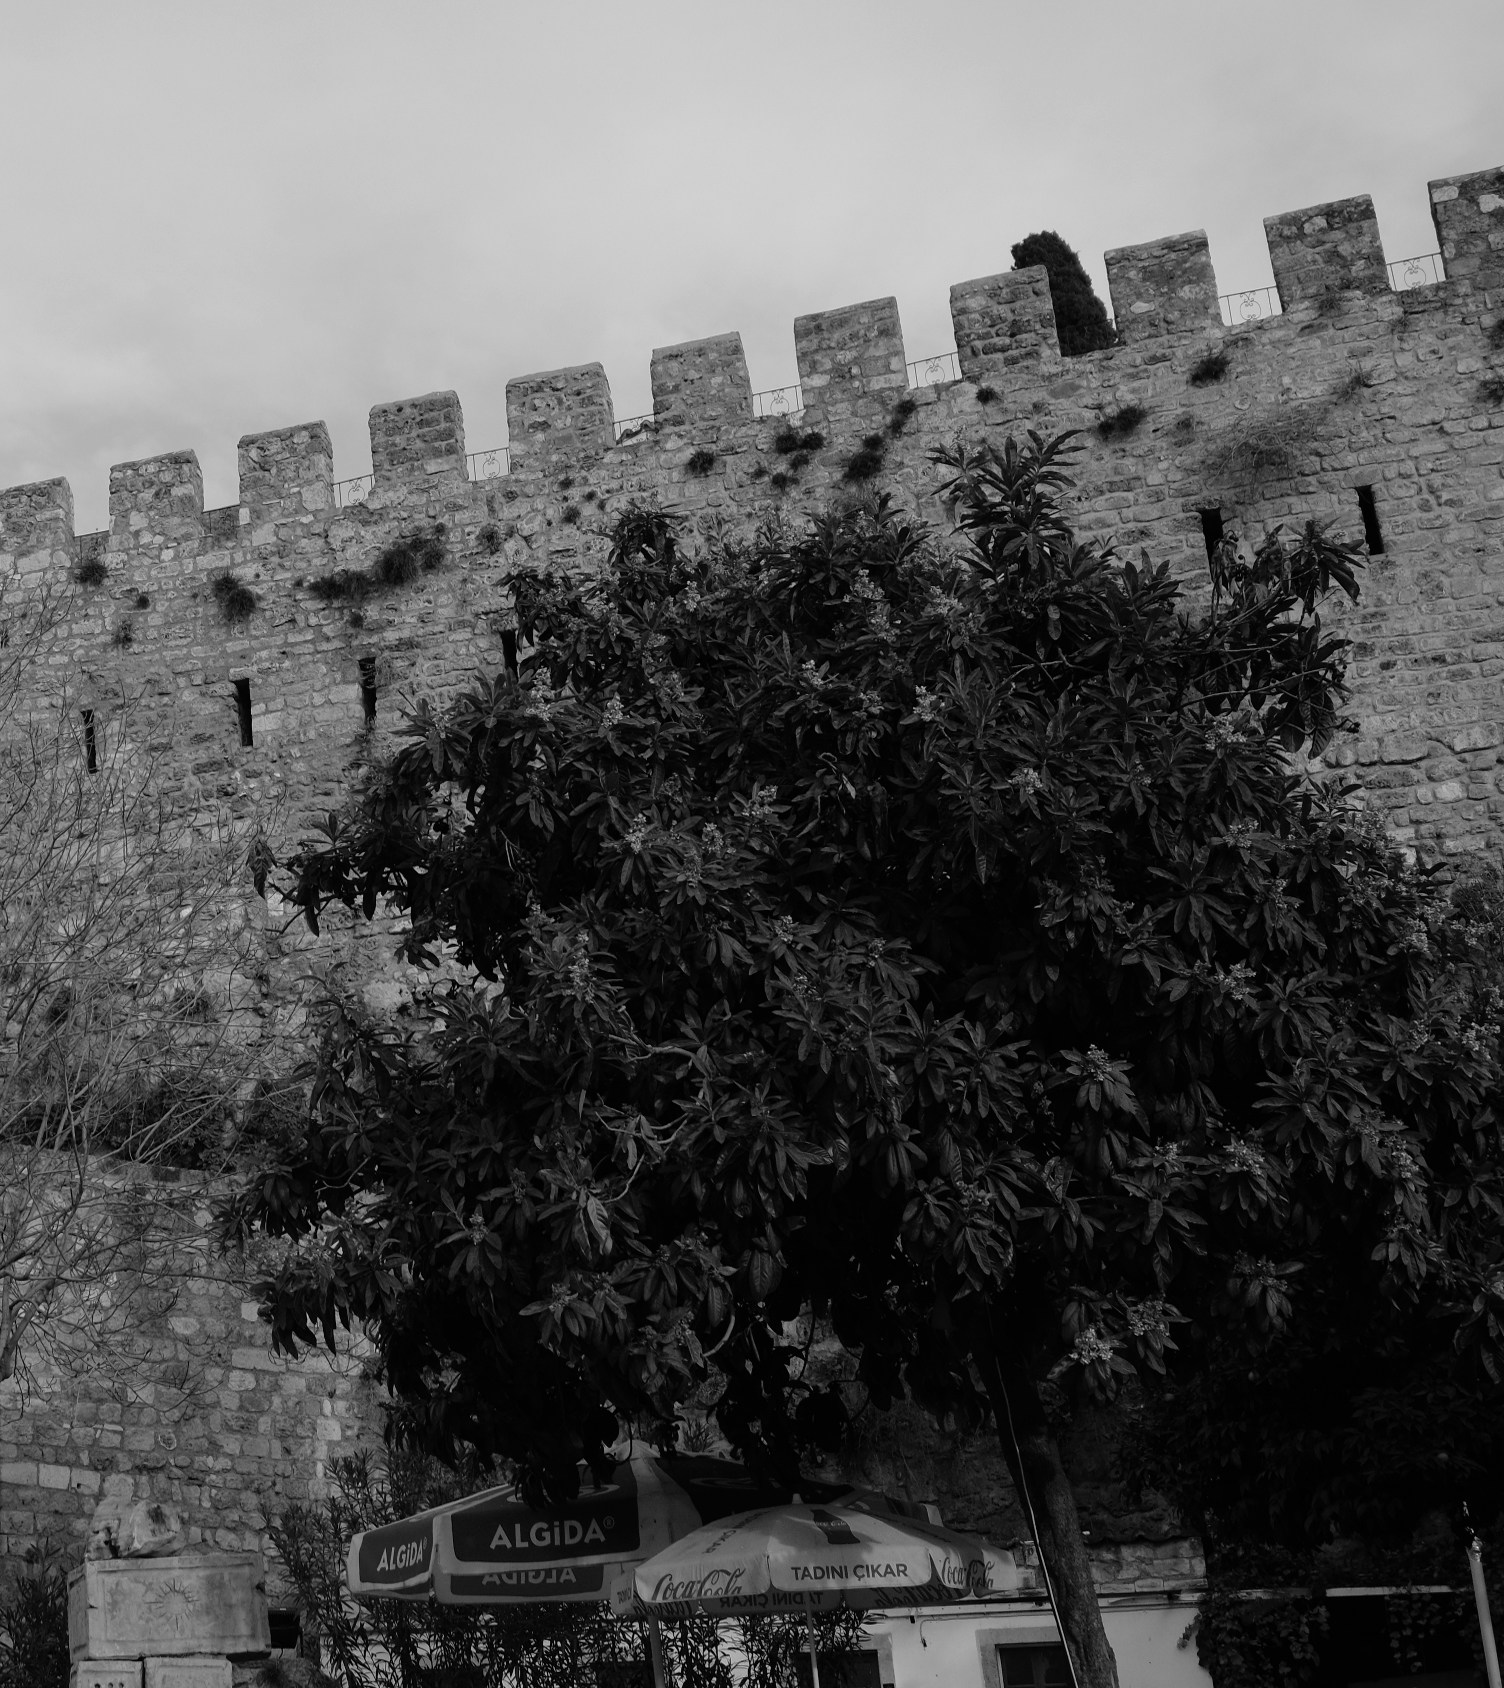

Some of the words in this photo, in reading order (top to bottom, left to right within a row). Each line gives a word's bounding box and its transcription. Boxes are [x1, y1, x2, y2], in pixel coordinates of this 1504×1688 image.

[651, 1567, 746, 1602] Coca-Cola
[791, 1565, 849, 1581] TADINI
[853, 1563, 908, 1582] ÇIKAR
